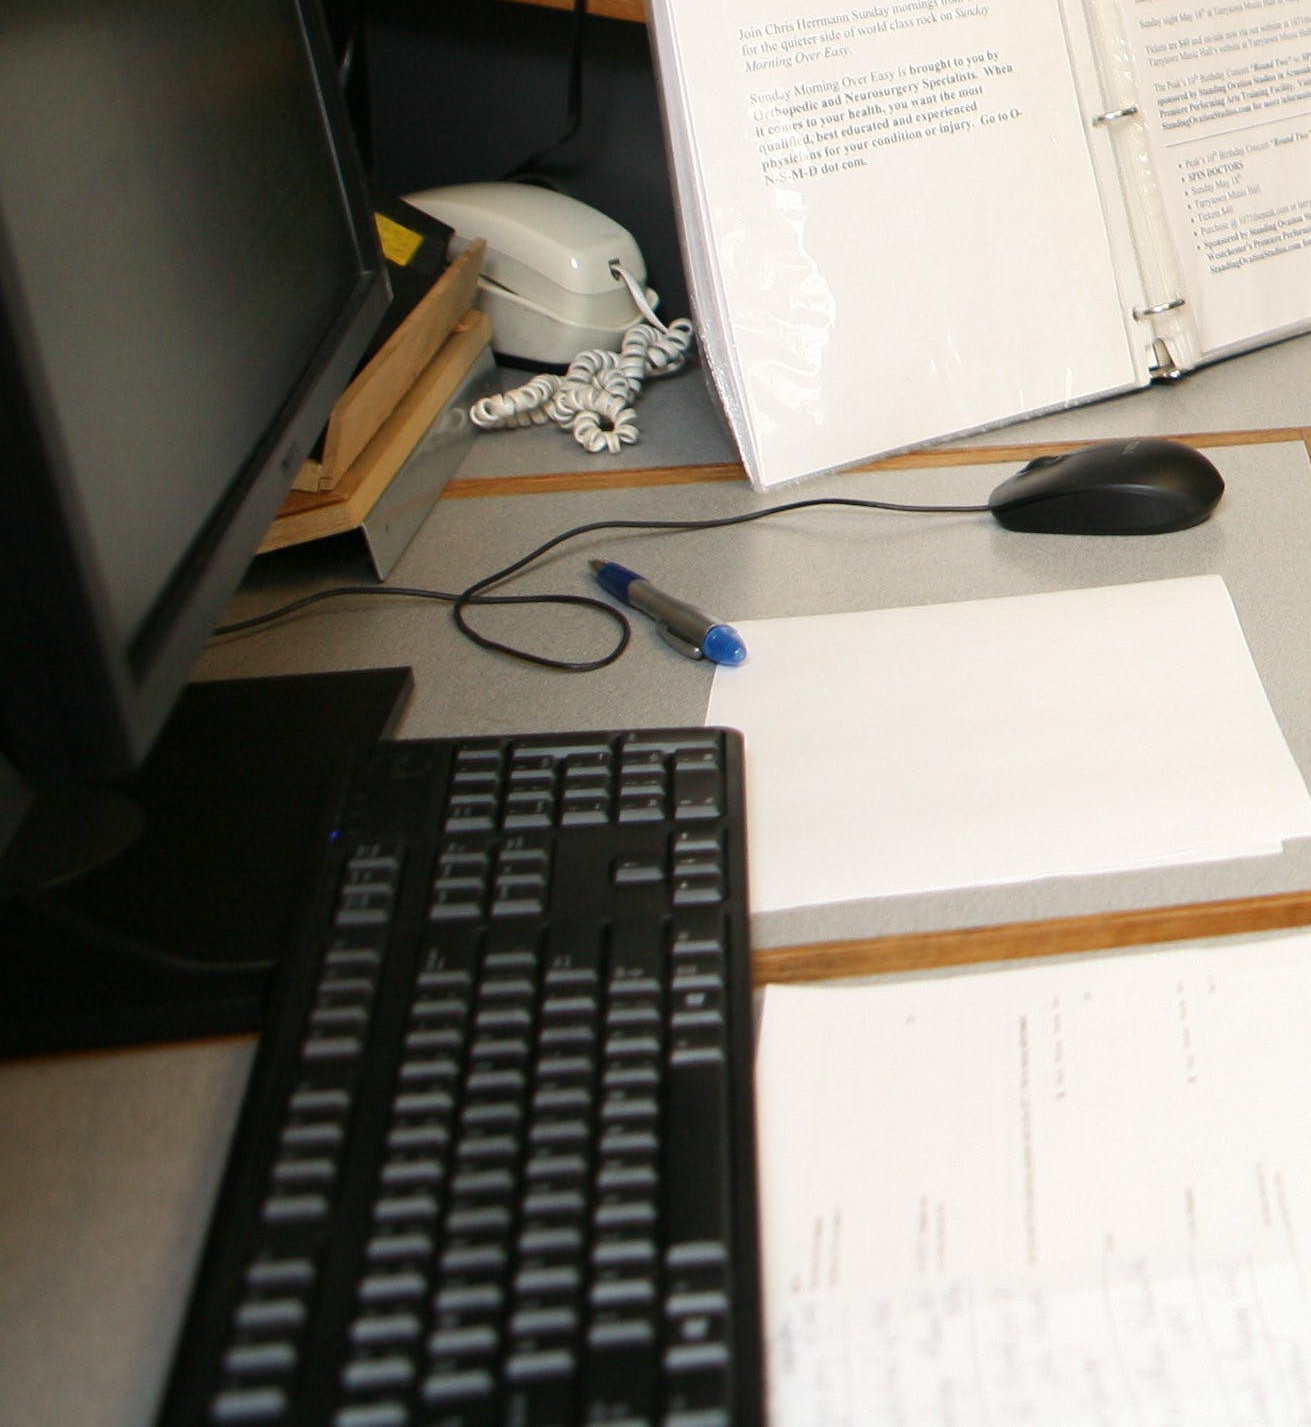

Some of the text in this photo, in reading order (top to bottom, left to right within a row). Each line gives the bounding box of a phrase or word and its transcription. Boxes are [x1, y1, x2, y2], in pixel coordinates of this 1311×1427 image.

[739, 27, 762, 40] Join
[764, 22, 794, 36] Chris
[797, 14, 849, 30] Herrmann
[852, 7, 889, 21] Sunday
[892, 0, 938, 14] mornings
[741, 6, 990, 56] for the quieter side of world class rock on Sunday
[745, 48, 853, 72] Morning Over Easy.
[750, 50, 999, 105] Sunday Morning Over Easy is brought to you by
[754, 65, 1013, 121] Orthopedic and Neurosurgery Specialists. When
[756, 127, 765, 138] it
[806, 118, 817, 128] to
[820, 114, 845, 127] your
[848, 104, 886, 119] health,
[888, 102, 908, 114] you
[910, 93, 937, 107] want
[940, 91, 956, 101] the
[958, 84, 983, 98] most
[816, 129, 838, 142] best
[841, 118, 890, 137] educated
[892, 114, 913, 127] and
[916, 101, 978, 122] experienced
[824, 146, 841, 156] for
[844, 141, 869, 155] your
[872, 130, 922, 147] condition
[924, 127, 936, 136] or
[939, 120, 975, 133] injury.
[980, 114, 996, 124] Go
[998, 111, 1008, 121] to
[765, 160, 866, 185] N-S-M-D dot com.
[1187, 161, 1243, 182] SPIN DOCTORS
